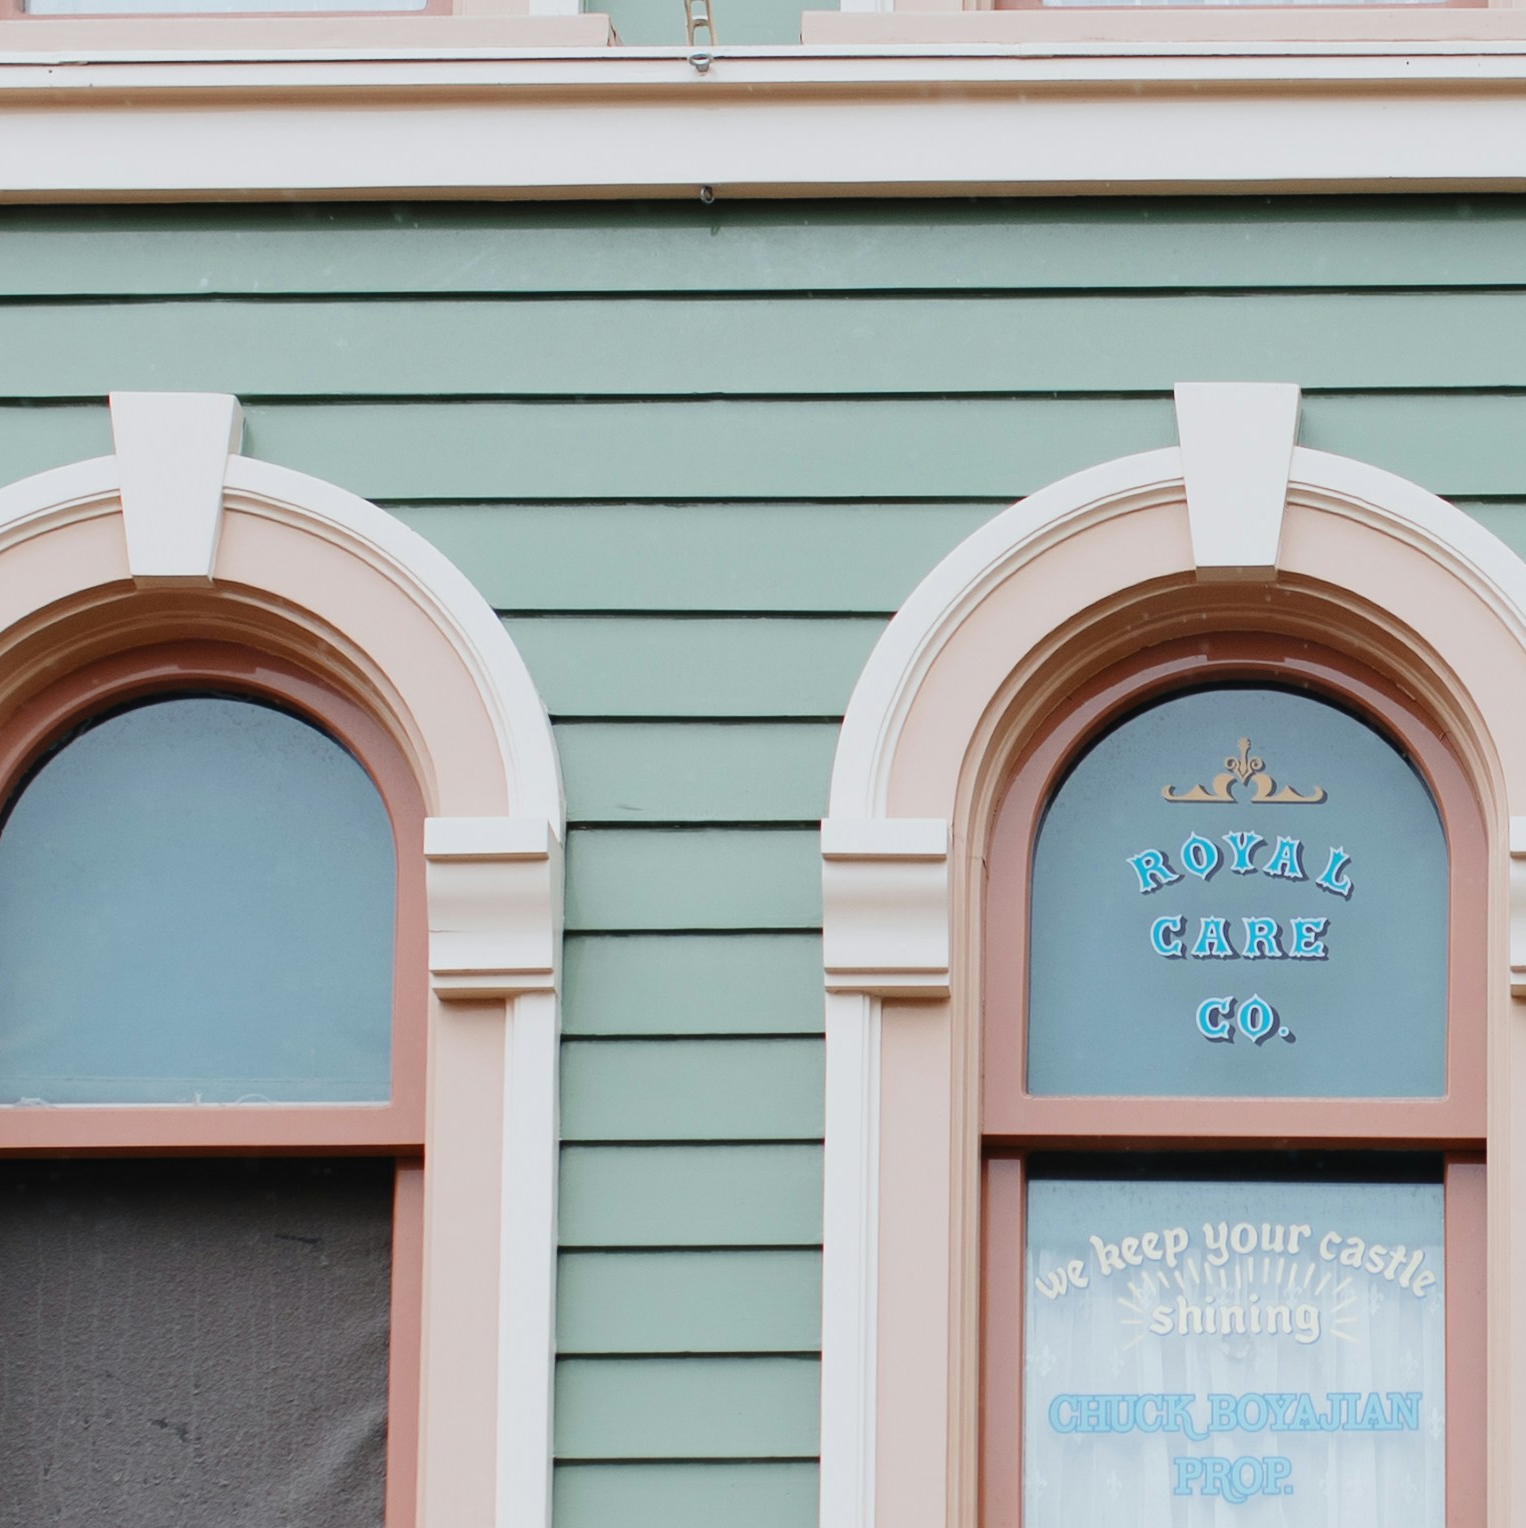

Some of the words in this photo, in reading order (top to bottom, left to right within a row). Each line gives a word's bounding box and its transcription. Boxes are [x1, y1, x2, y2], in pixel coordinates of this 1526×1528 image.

[1126, 831, 1354, 901] ROYAL
[1150, 914, 1331, 961] CARE
[1196, 993, 1297, 1047] CO.
[1035, 1259, 1090, 1300] we
[1090, 1226, 1189, 1277] keep
[1202, 1221, 1311, 1266] your
[1319, 1230, 1436, 1298] castle
[1149, 1293, 1321, 1345] shining
[1048, 1394, 1209, 1441] CHUCK
[1207, 1391, 1423, 1433] BOYAJIAN
[1173, 1456, 1293, 1504] PROP.
